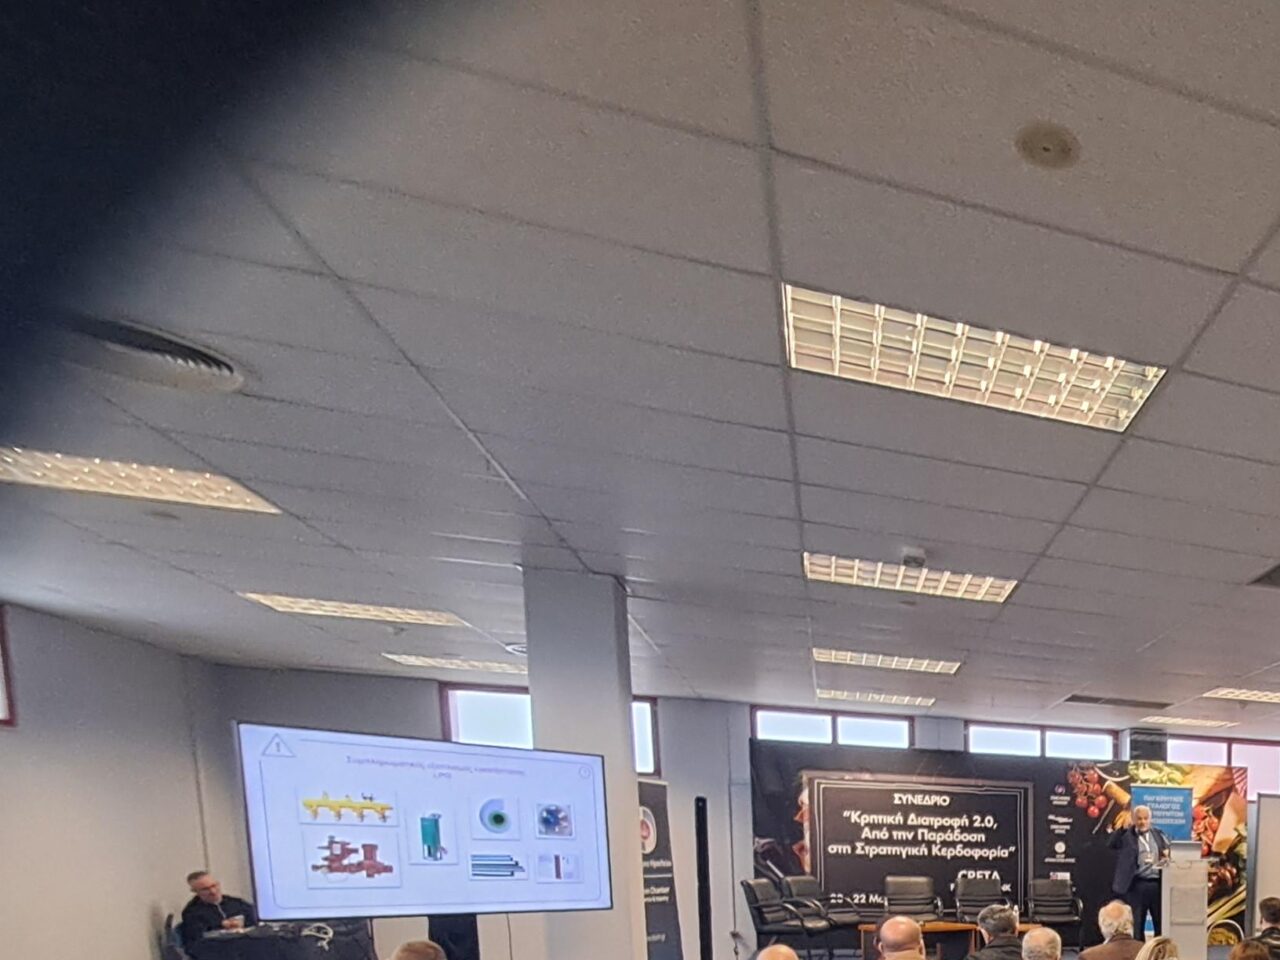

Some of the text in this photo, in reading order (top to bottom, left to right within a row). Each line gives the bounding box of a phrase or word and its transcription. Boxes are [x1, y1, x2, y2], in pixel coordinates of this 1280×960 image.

[893, 793, 950, 806] ΣΥΝΕΔΡΙΟ
[907, 812, 969, 829] Διατροφή
[972, 815, 998, 830] 2.0,
[861, 827, 986, 844] Από την Παράδοση
[828, 845, 851, 855] στη
[855, 842, 928, 859] Στρατηγική
